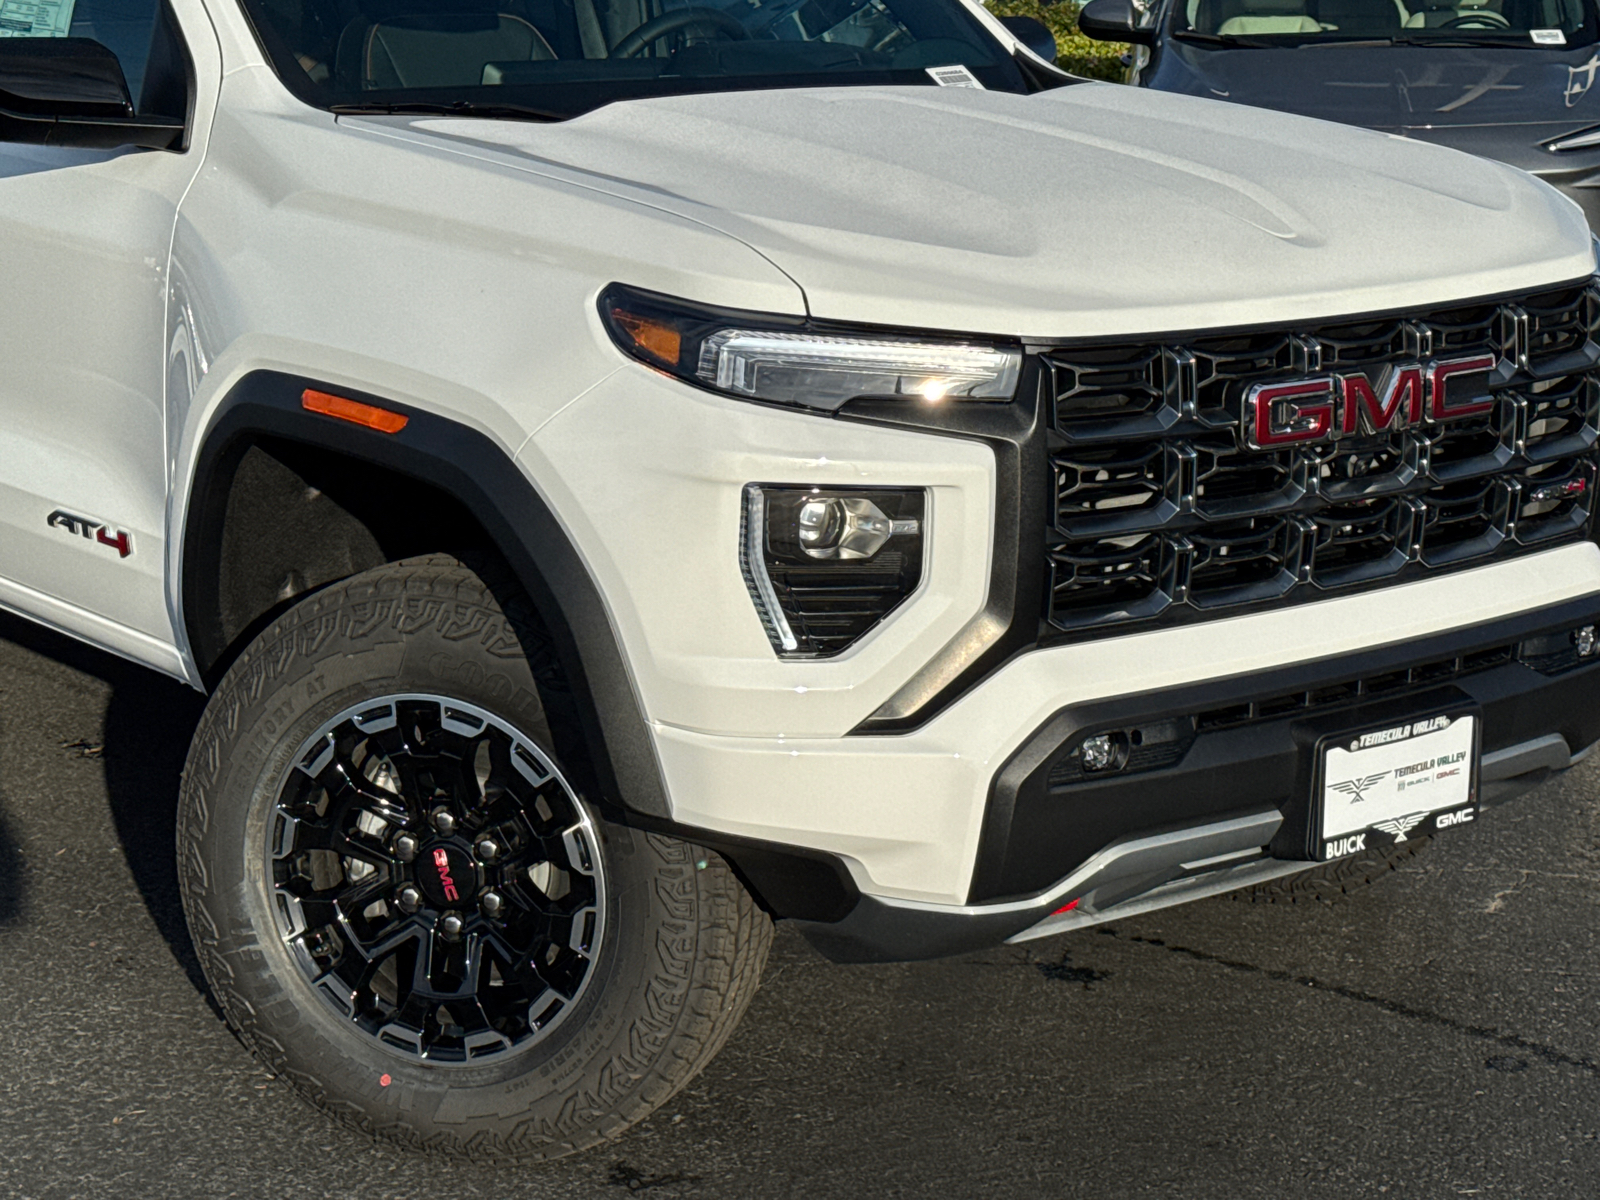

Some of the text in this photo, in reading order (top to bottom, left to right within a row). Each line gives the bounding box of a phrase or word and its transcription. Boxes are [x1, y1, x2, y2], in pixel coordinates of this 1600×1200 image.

[1243, 353, 1497, 450] GMC
[47, 508, 132, 558] AT4
[1359, 724, 1411, 748] TEMECULA
[1394, 750, 1467, 779] TEMECULA VALLEY
[1436, 768, 1460, 780] GMC
[1436, 808, 1474, 829] GMC
[1326, 833, 1366, 860] BUICK
[433, 848, 460, 902] GMC
